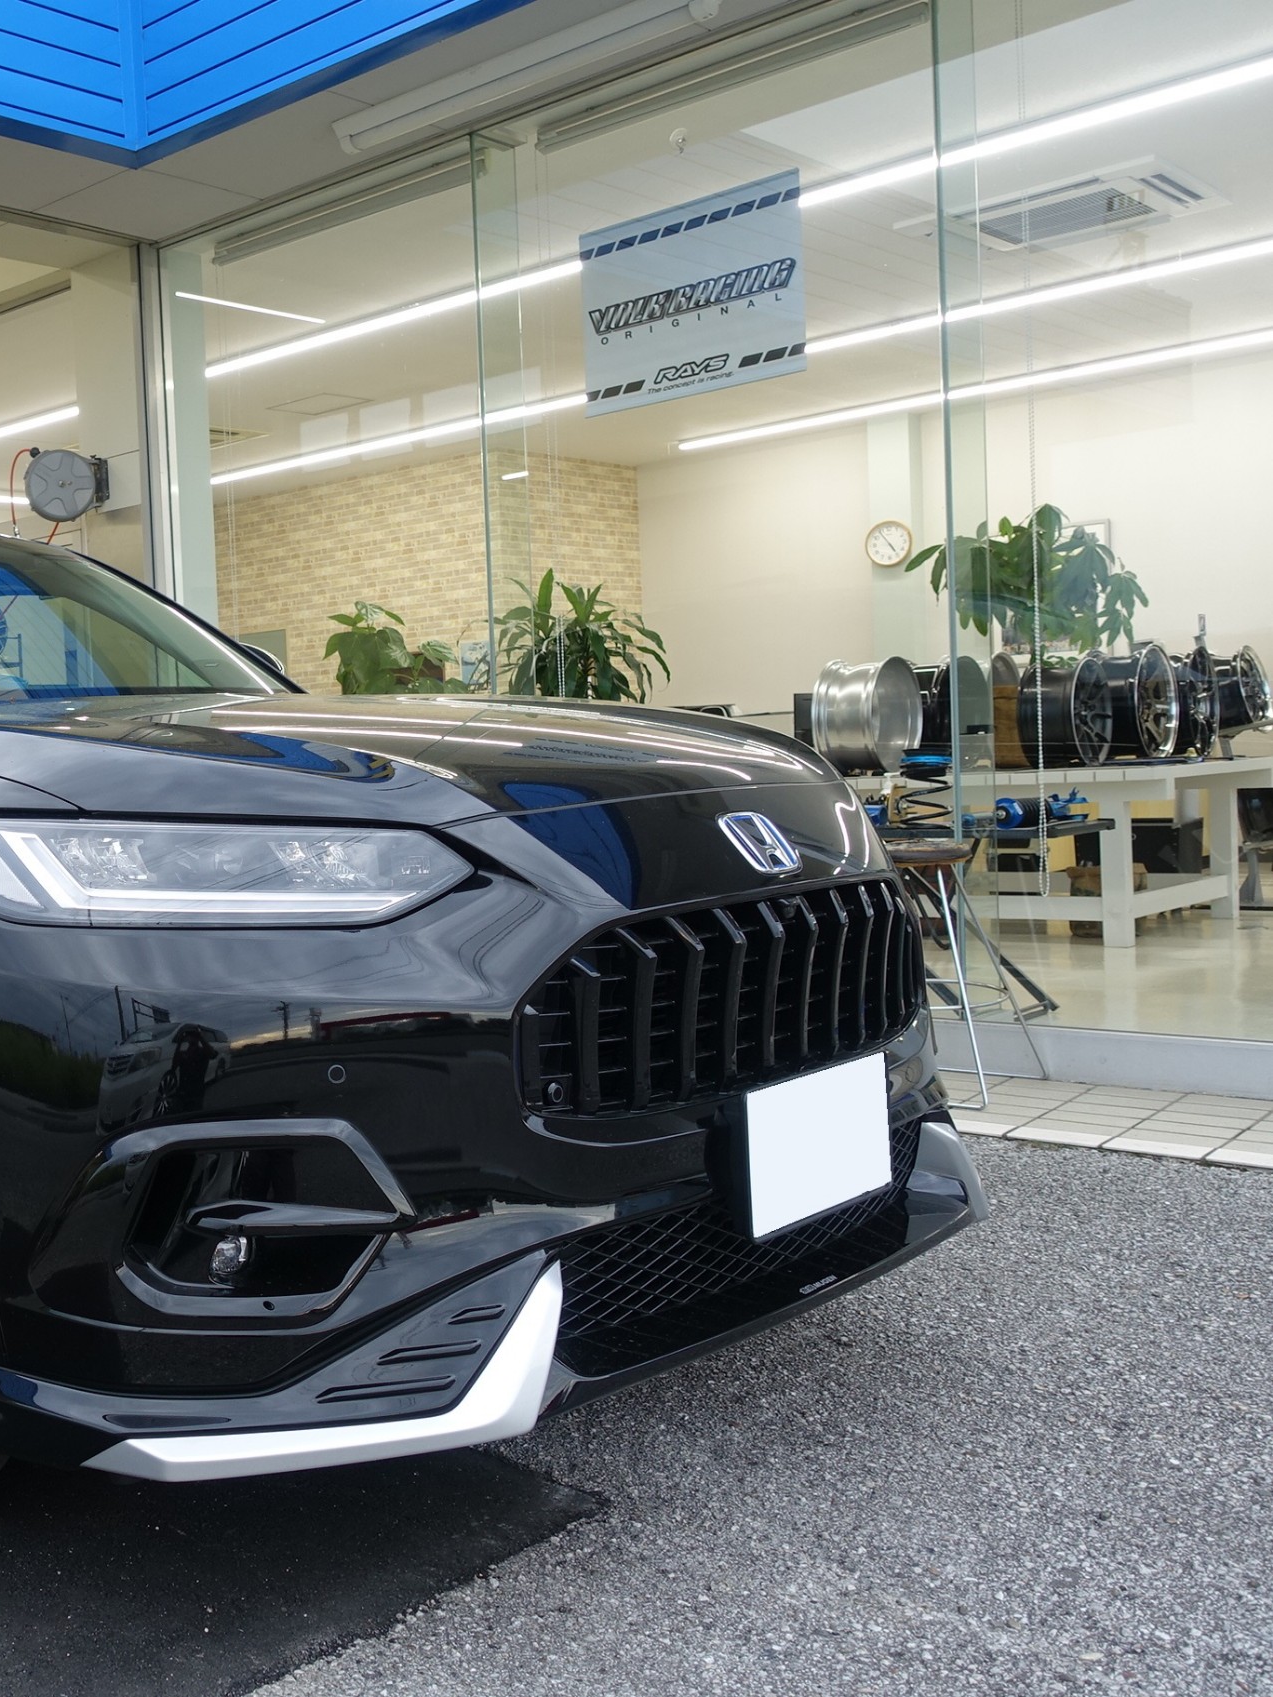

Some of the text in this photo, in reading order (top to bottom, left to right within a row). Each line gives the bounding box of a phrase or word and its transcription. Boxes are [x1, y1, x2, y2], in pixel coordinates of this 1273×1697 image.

[588, 257, 797, 336] VOLK RACING
[600, 292, 783, 346] ORIGINAL
[648, 387, 662, 395] The
[663, 379, 696, 392] concept
[653, 353, 730, 385] RAYS
